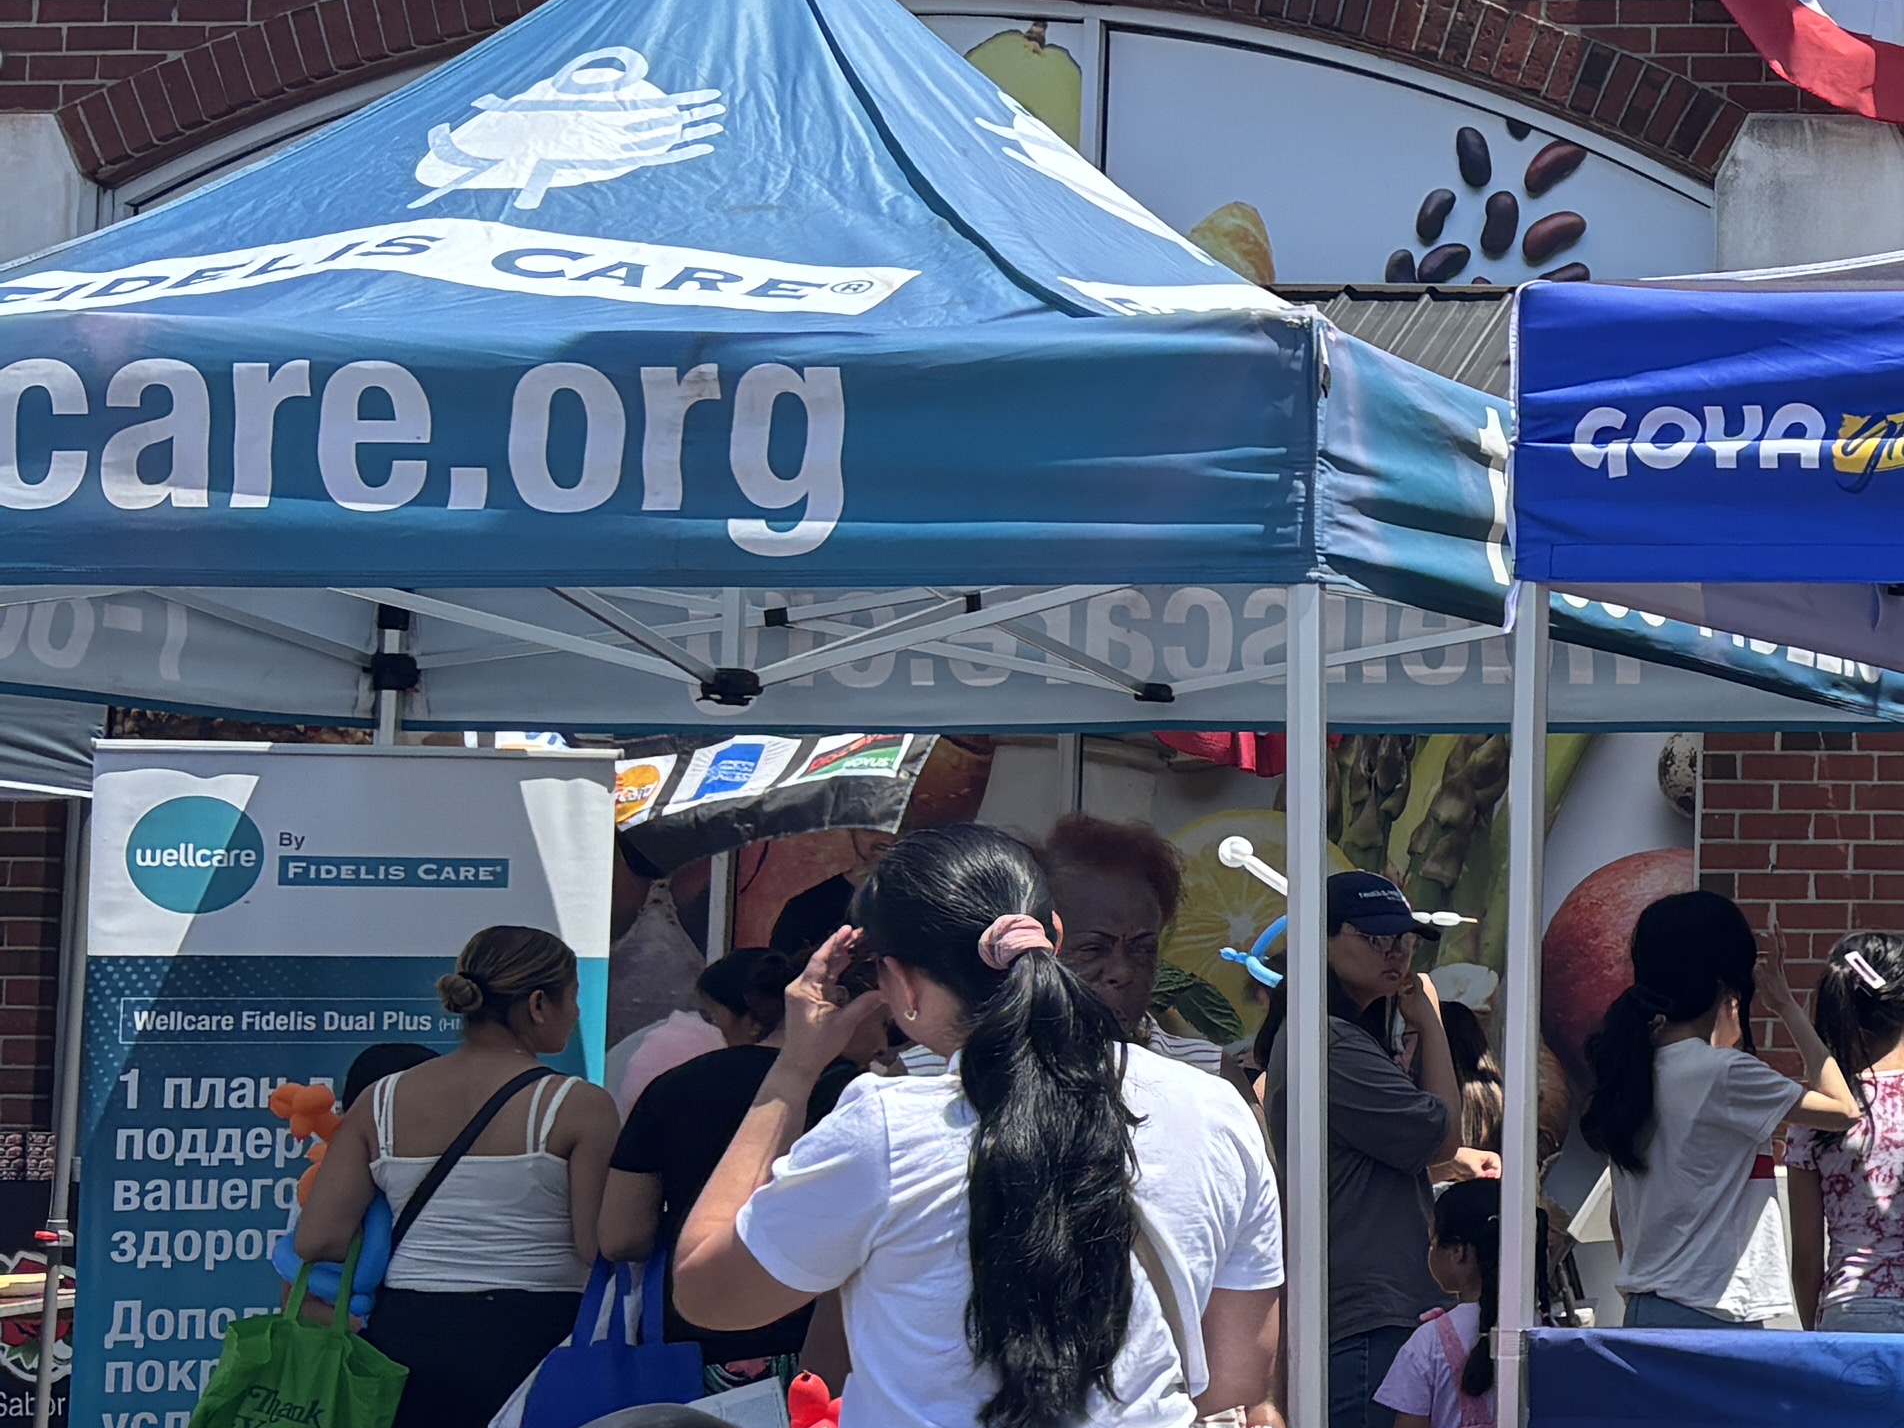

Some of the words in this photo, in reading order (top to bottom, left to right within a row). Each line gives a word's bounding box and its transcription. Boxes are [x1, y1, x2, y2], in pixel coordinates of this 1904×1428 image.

[1570, 403, 1827, 478] GOYA
[278, 832, 306, 853] By
[135, 844, 256, 869] wellcare
[287, 862, 406, 881] FIDELIS
[134, 1011, 234, 1032] Wellcare
[241, 1011, 316, 1032] Fidelis
[324, 1011, 377, 1032] Dual
[382, 1011, 432, 1032] Plus
[119, 1068, 140, 1110] 1
[115, 1127, 312, 1169] поддер
